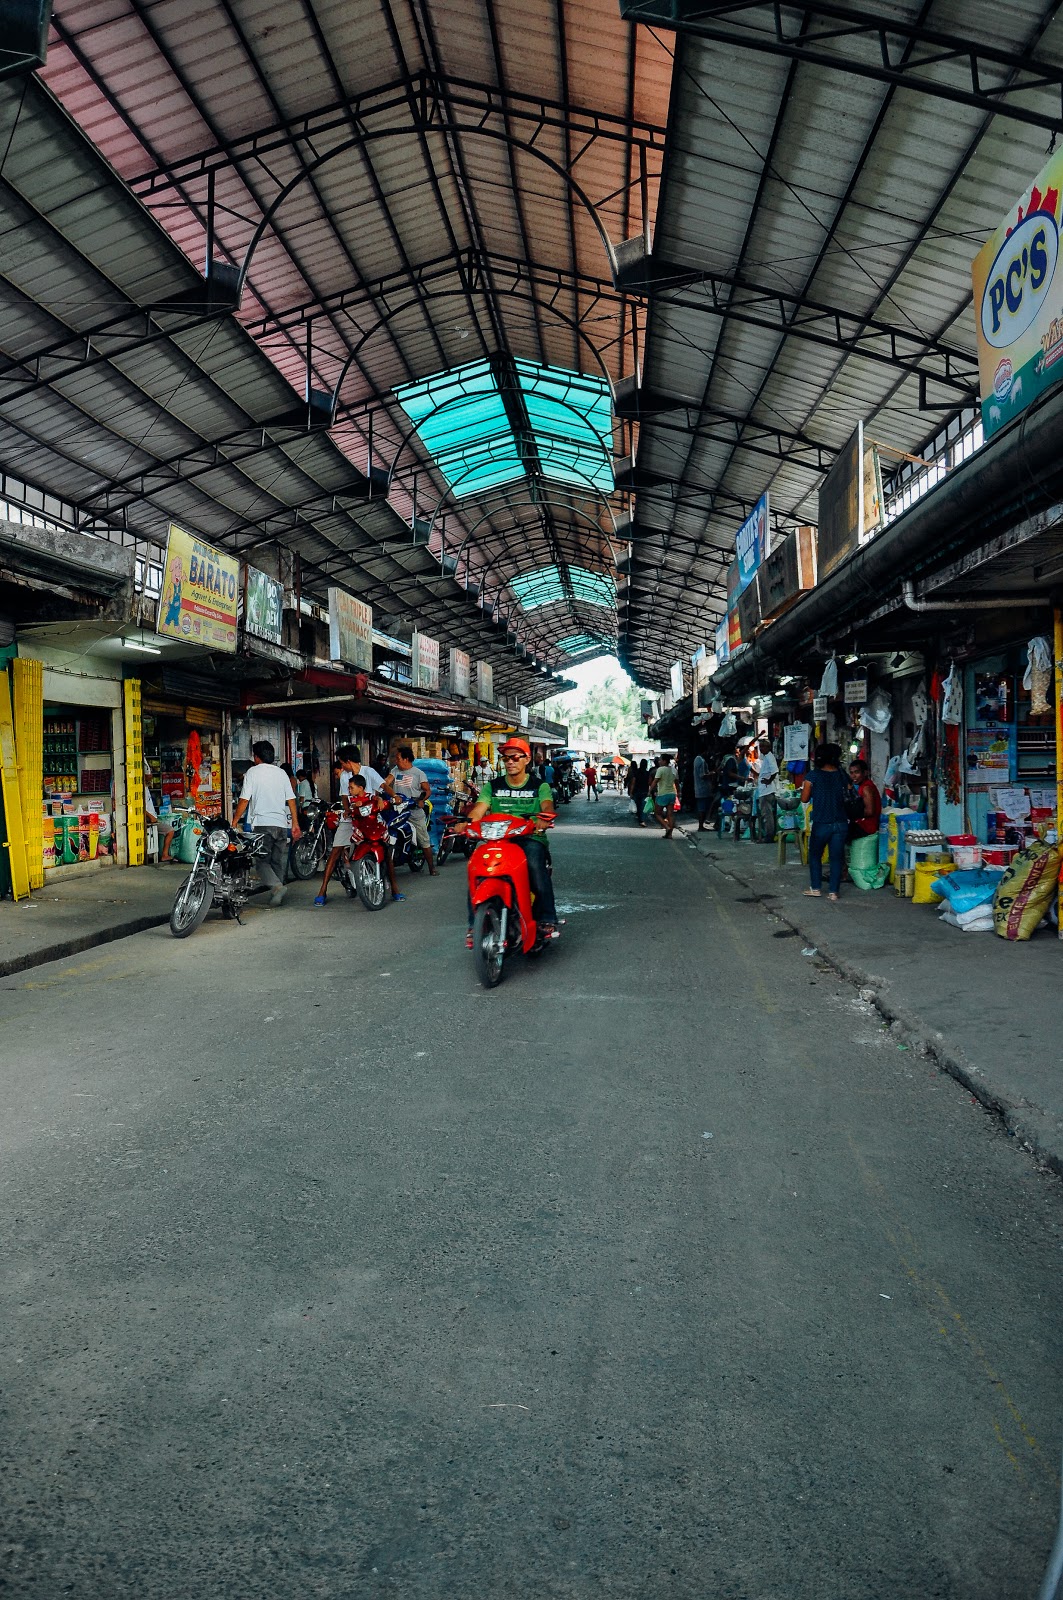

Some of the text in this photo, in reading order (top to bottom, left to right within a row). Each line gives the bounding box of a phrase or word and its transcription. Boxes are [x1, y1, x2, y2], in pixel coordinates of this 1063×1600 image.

[989, 229, 1048, 333] PC'S
[193, 541, 220, 565] MEGA
[189, 555, 235, 602] BARATO
[495, 789, 534, 798] JAG BLACK
